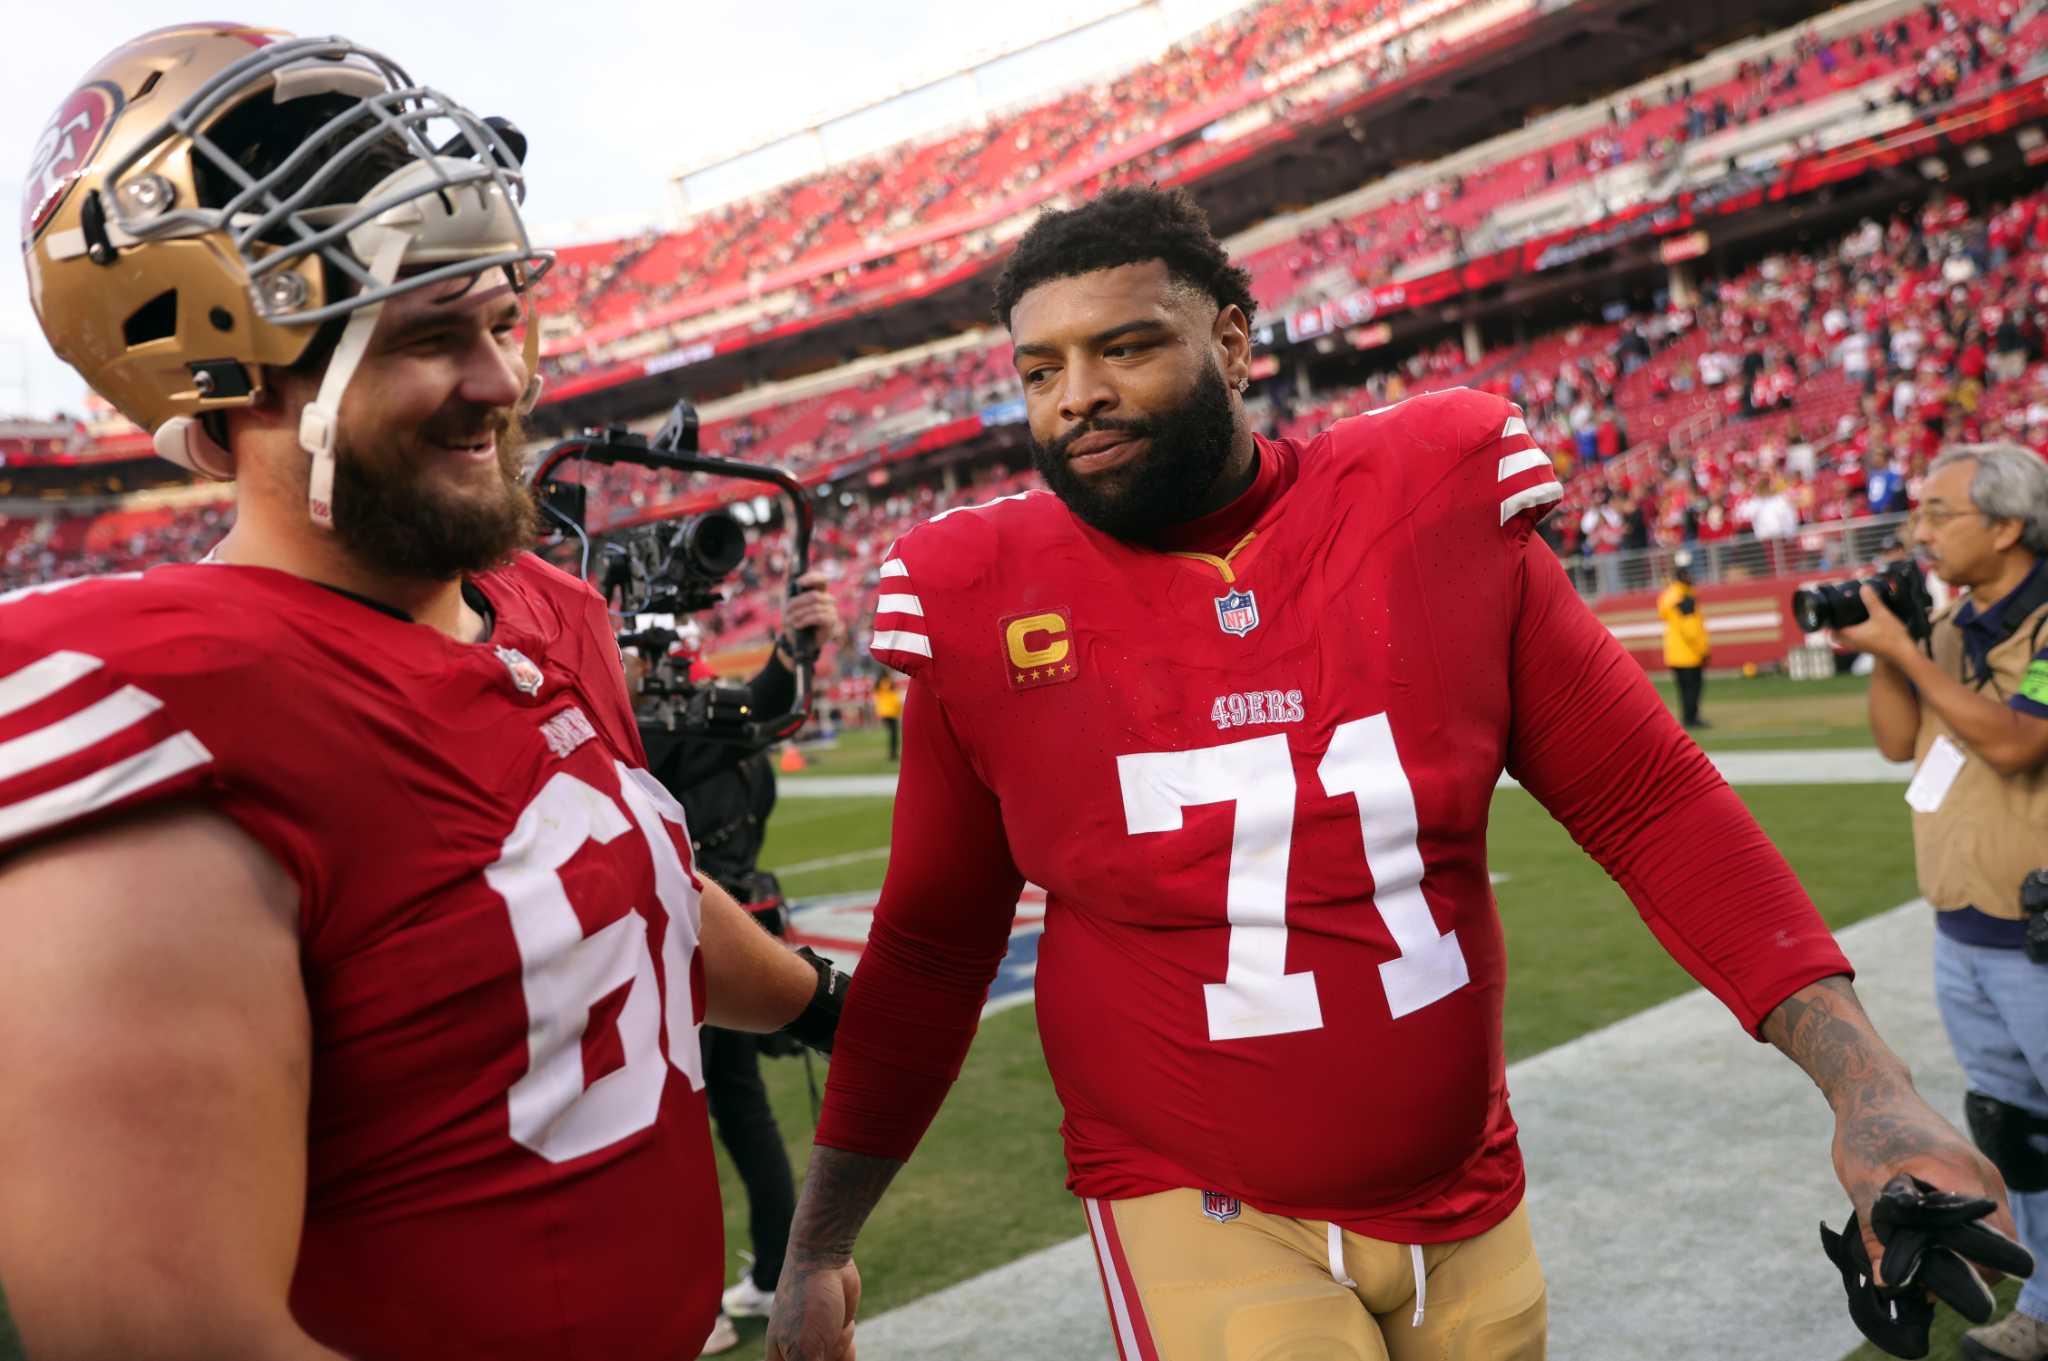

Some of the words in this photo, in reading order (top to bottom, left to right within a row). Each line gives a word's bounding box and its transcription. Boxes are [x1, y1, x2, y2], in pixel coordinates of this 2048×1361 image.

[1006, 613, 1069, 669] C
[1223, 608, 1254, 629] NFL
[1210, 690, 1305, 730] 49ERS
[1116, 711, 1470, 1041] 71
